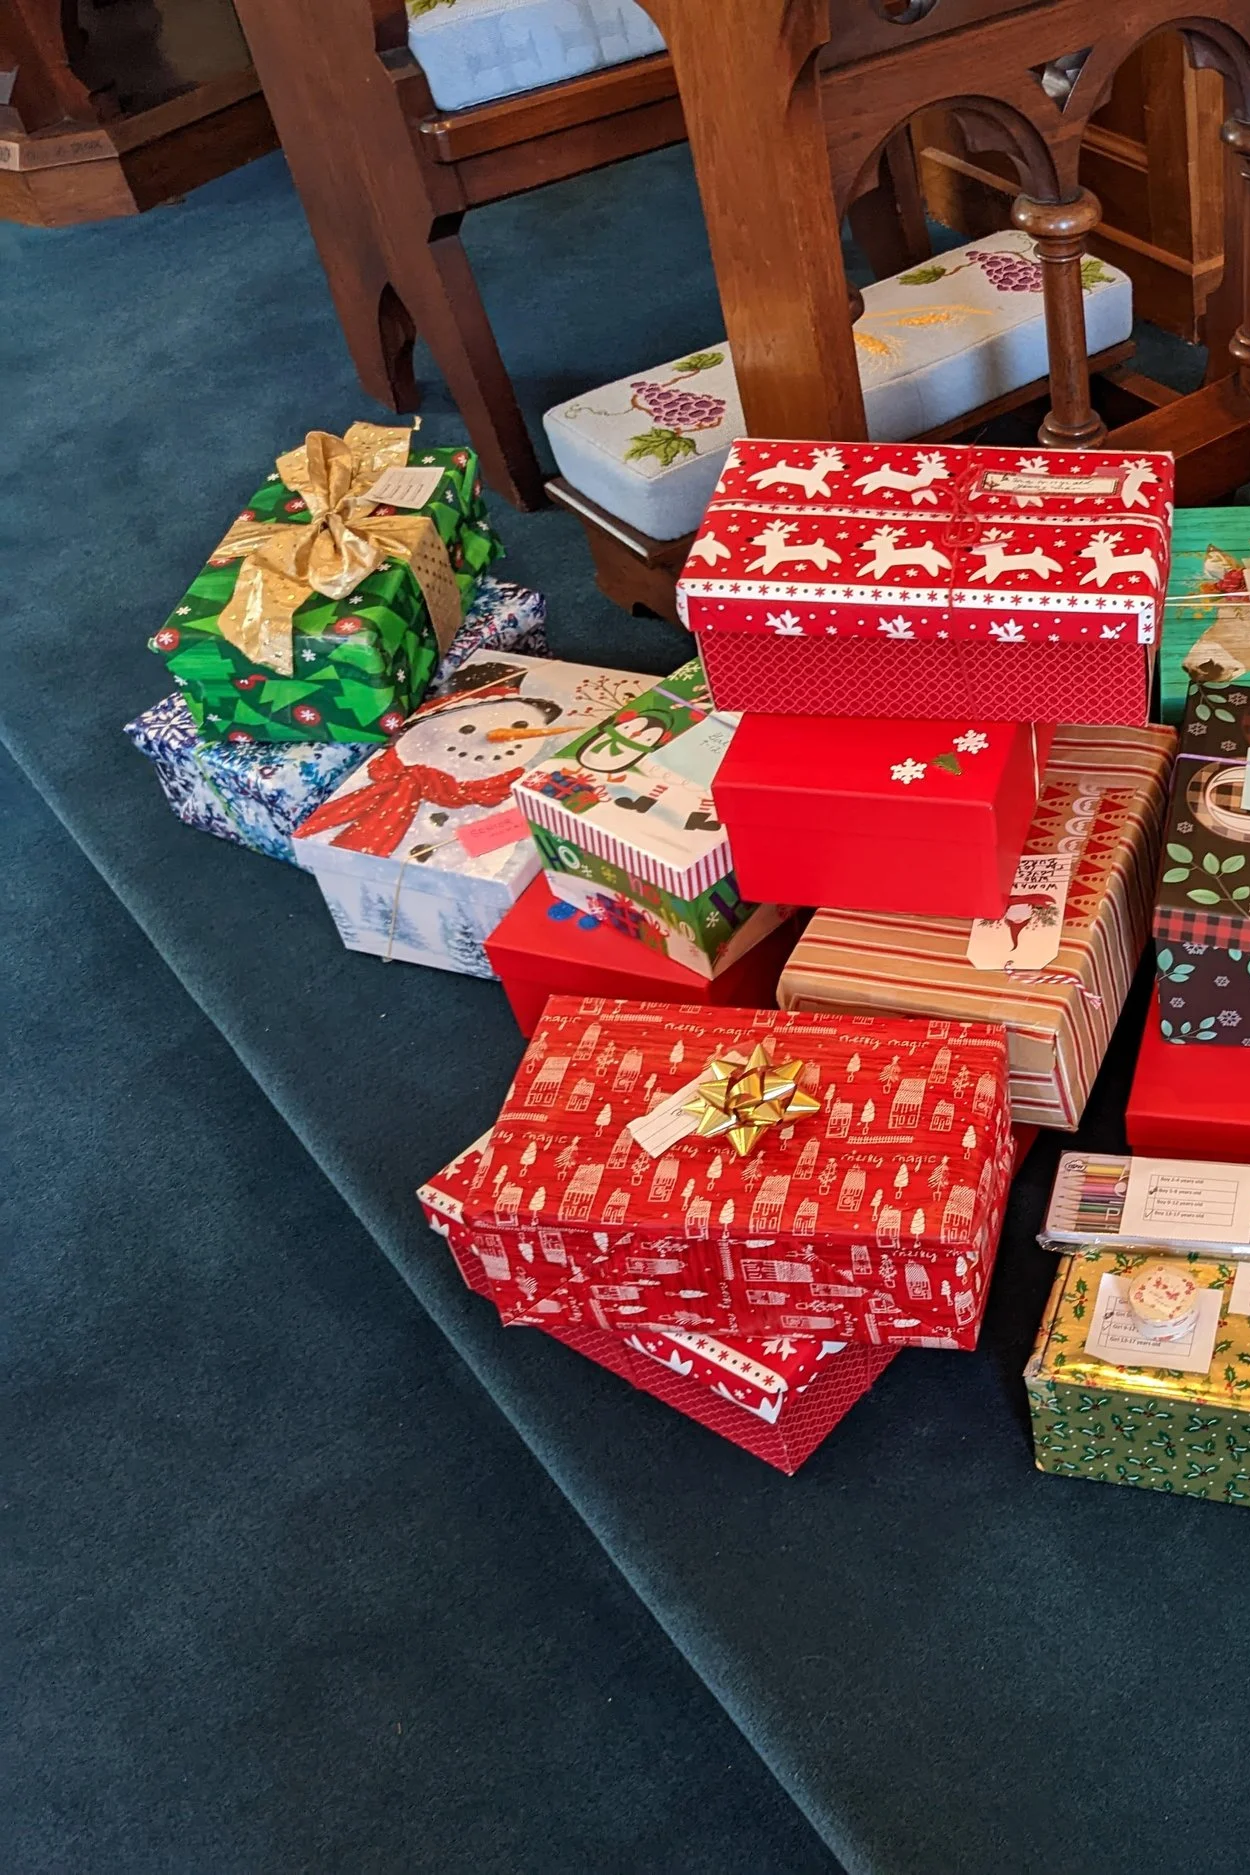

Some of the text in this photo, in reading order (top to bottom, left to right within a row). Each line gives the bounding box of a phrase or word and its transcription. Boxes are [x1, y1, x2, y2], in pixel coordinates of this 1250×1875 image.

[664, 1022, 755, 1042] merry magic
[839, 1034, 930, 1055] merry magic
[522, 1131, 568, 1150] magic
[841, 1151, 937, 1172] merry magic
